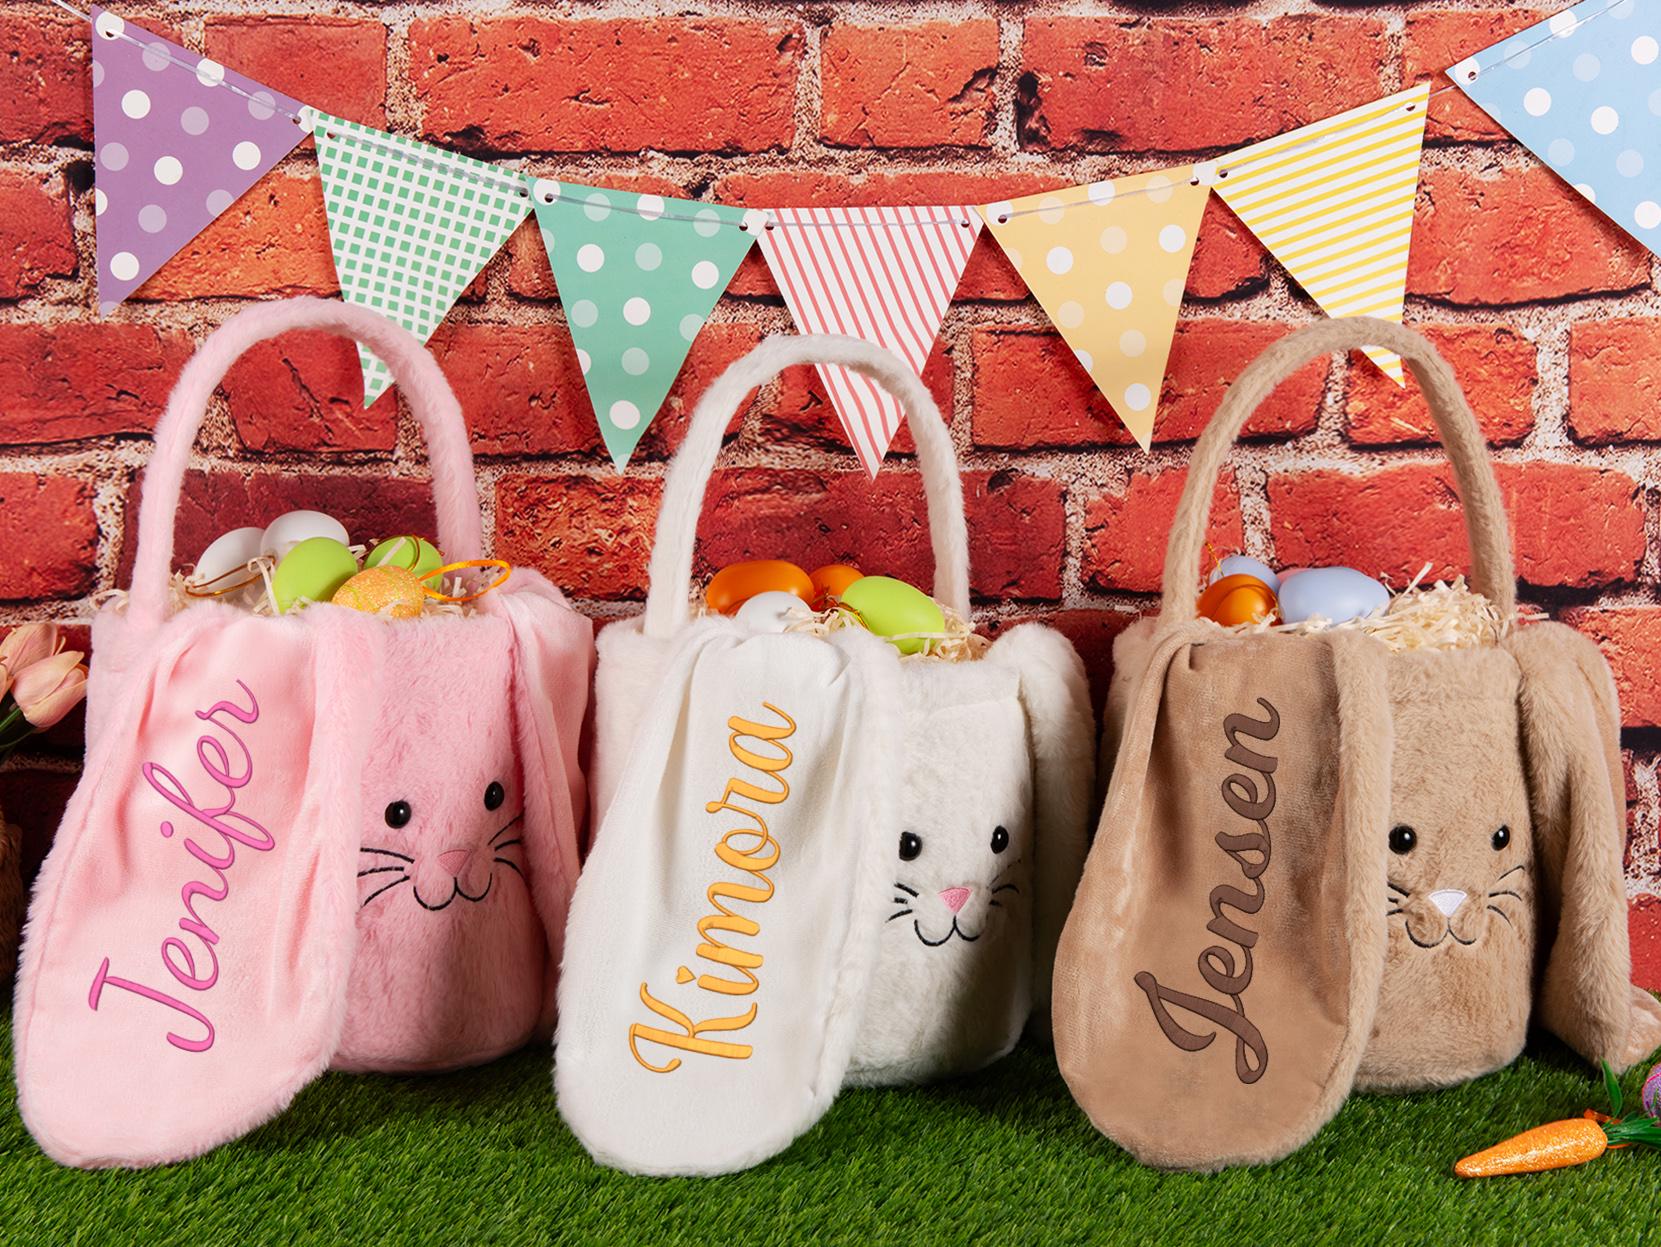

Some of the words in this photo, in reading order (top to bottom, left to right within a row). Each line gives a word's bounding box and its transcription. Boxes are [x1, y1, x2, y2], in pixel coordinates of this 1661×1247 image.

[88, 679, 275, 1053] Jenifer
[629, 701, 796, 1074] Kimora
[1134, 697, 1280, 1084] Jensen
